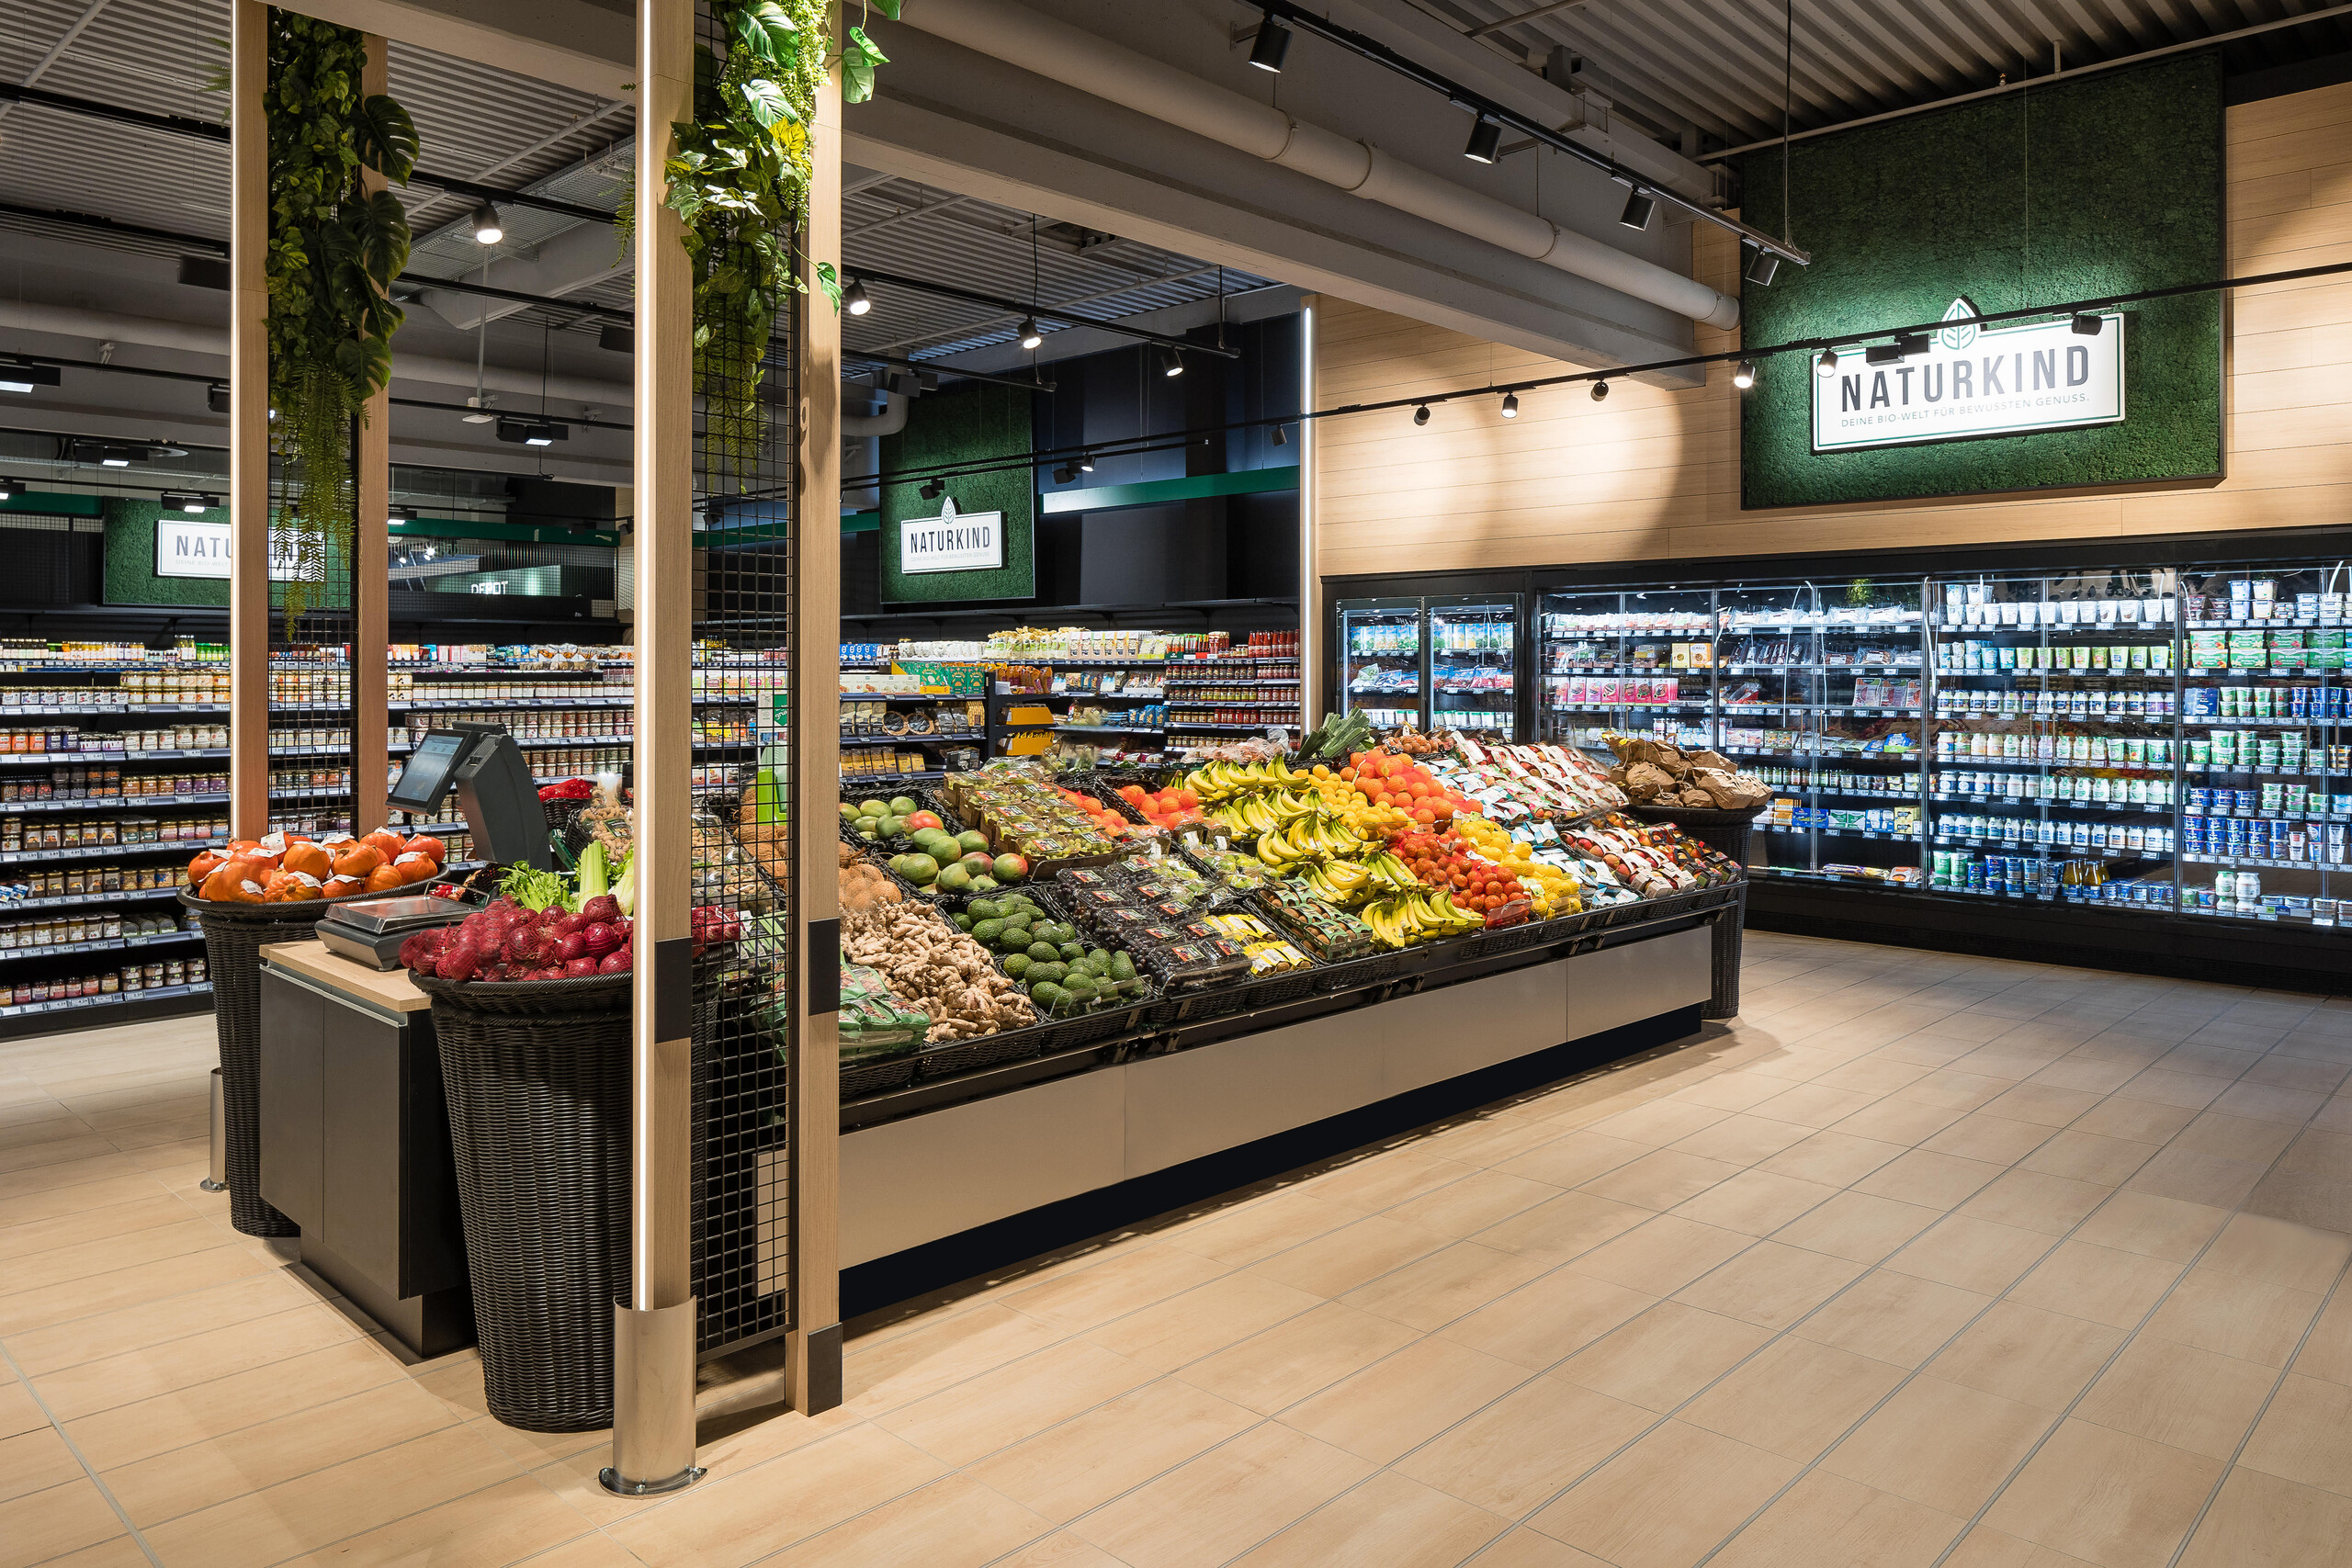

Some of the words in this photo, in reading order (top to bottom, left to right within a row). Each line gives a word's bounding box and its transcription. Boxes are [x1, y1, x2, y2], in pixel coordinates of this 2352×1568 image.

[1841, 345, 2089, 412] NATURKIND
[1841, 417, 1874, 428] DEINE
[1878, 410, 1930, 423] BIO-WELT
[1934, 406, 1955, 417] FÜR
[1960, 400, 2031, 414] BEWUSSTEN
[2035, 392, 2090, 407] GENUSS.
[910, 526, 990, 554] NATURKIND
